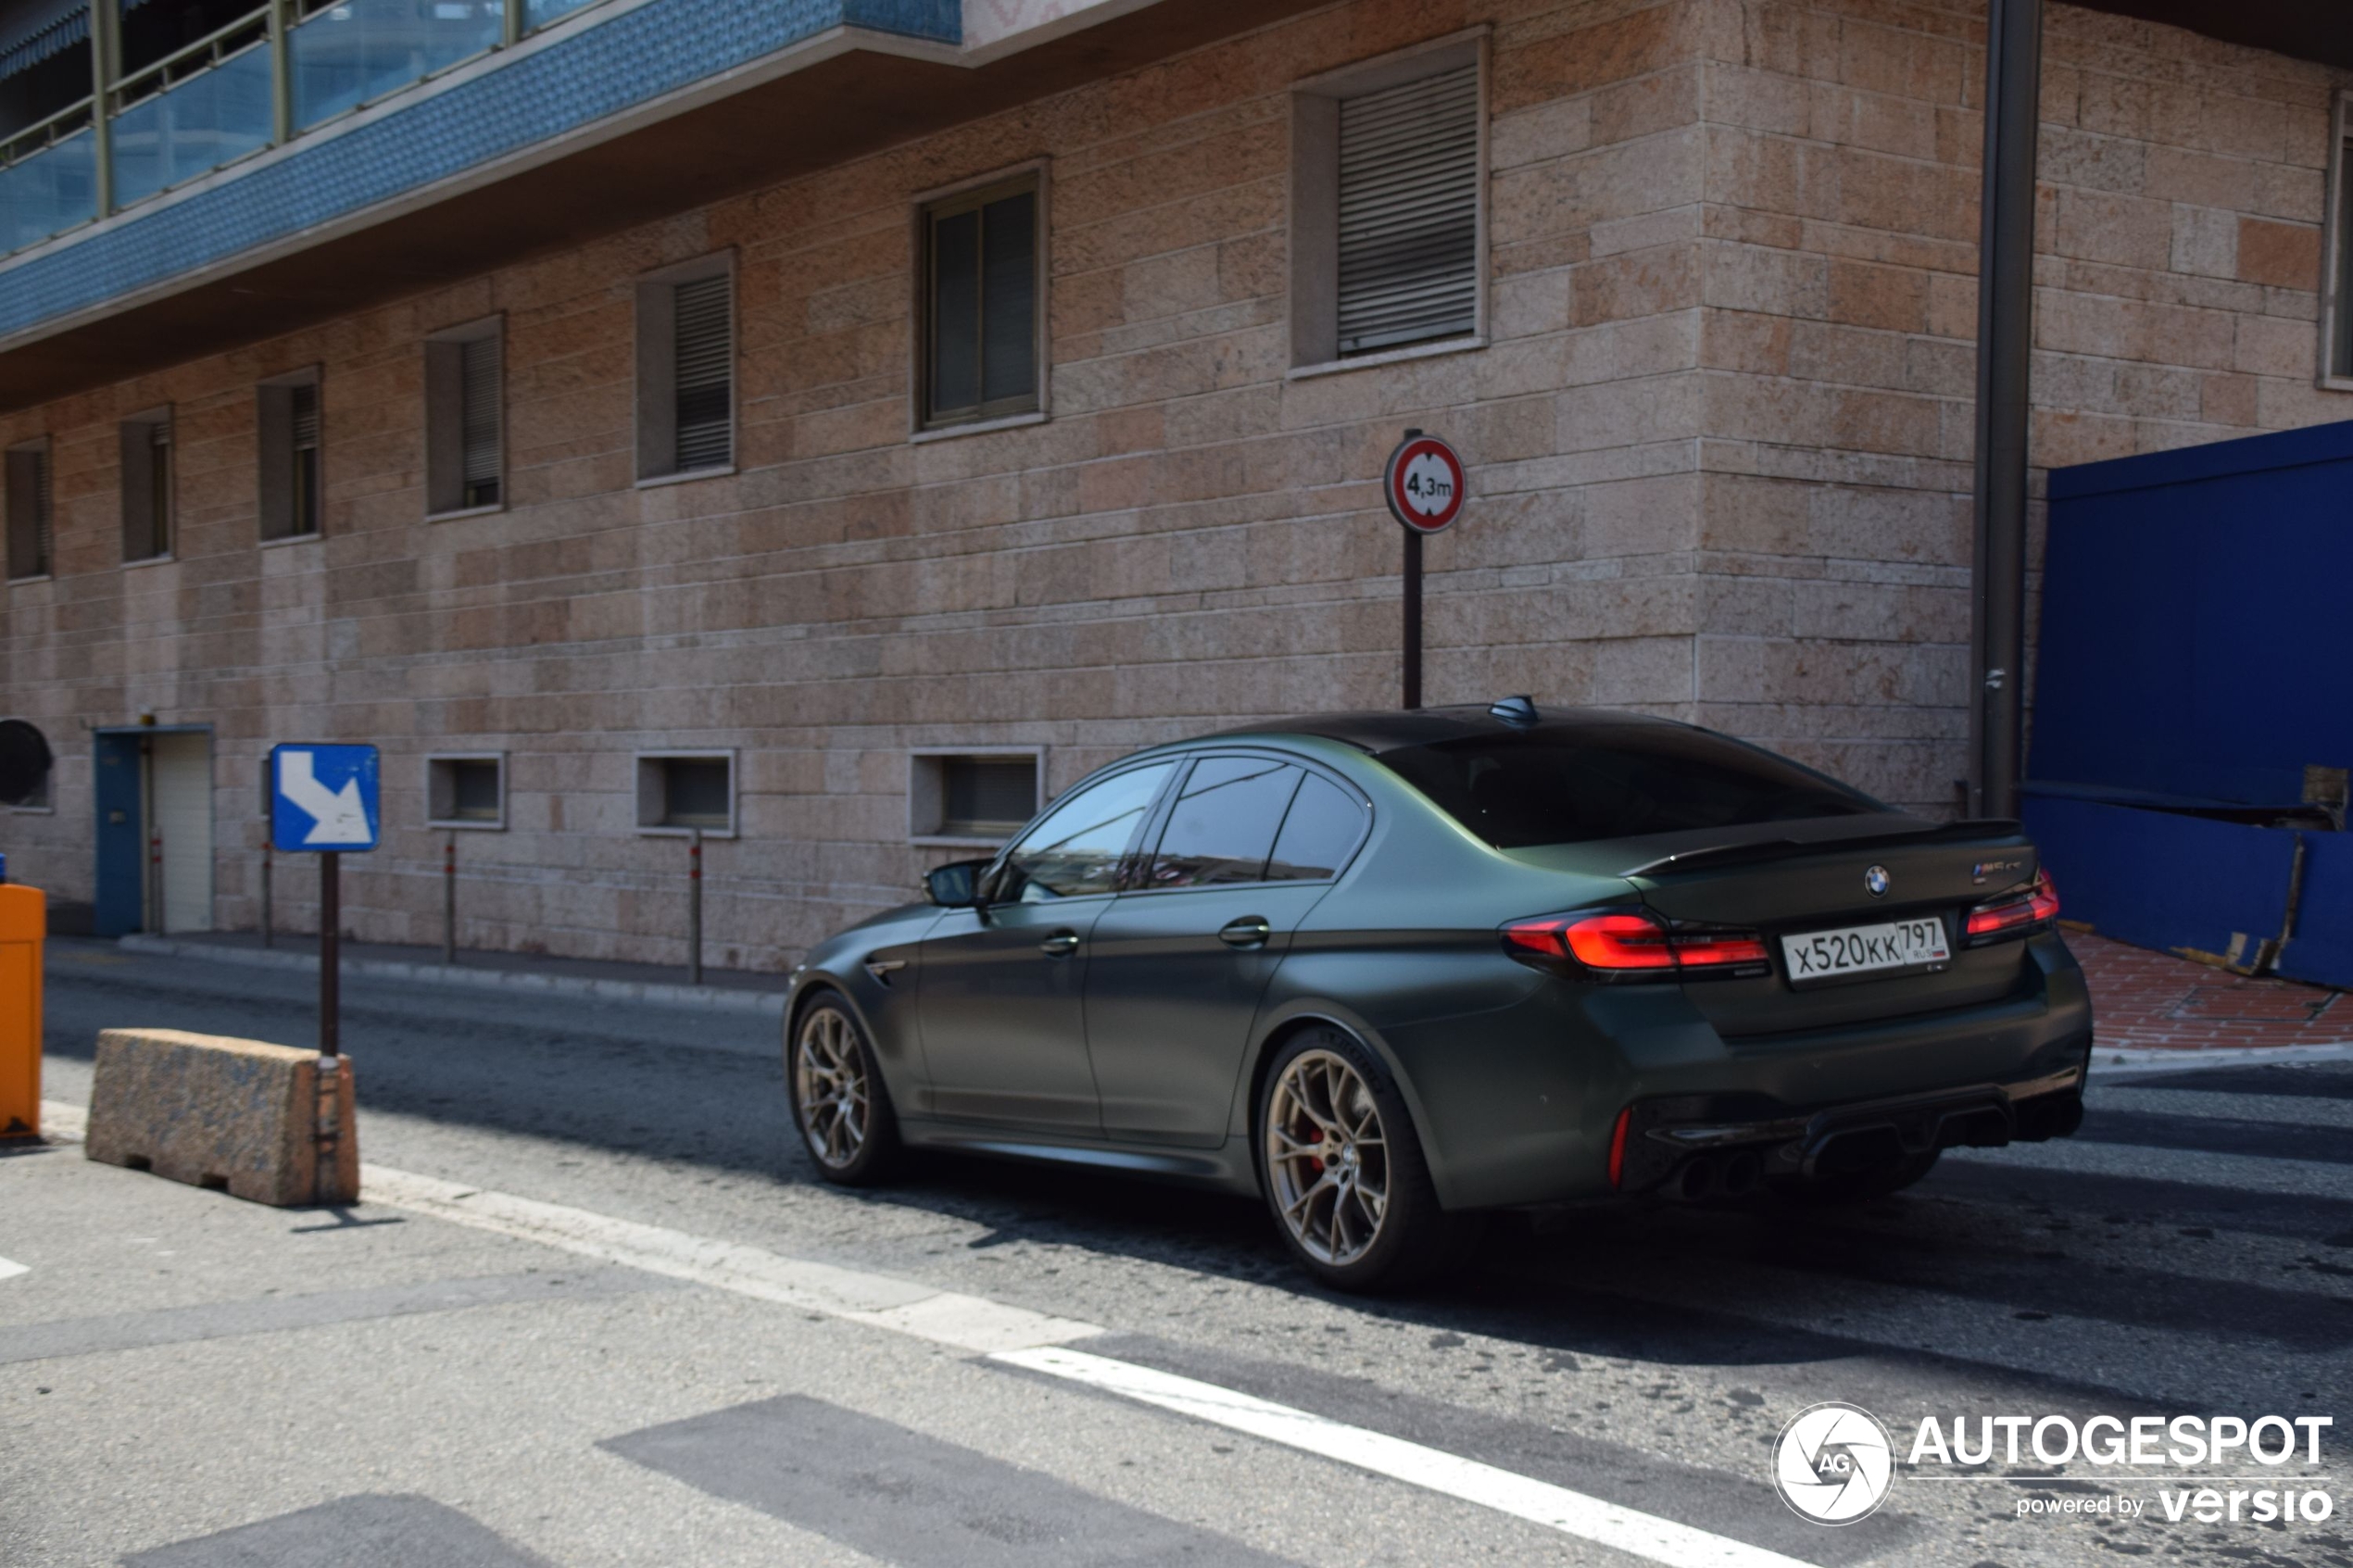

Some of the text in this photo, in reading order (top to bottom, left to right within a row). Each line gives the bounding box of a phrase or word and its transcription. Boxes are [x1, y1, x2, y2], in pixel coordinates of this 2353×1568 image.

[1407, 472, 1452, 498] 4,3m
[1899, 922, 1936, 949] 797
[1913, 949, 1933, 960] RUS
